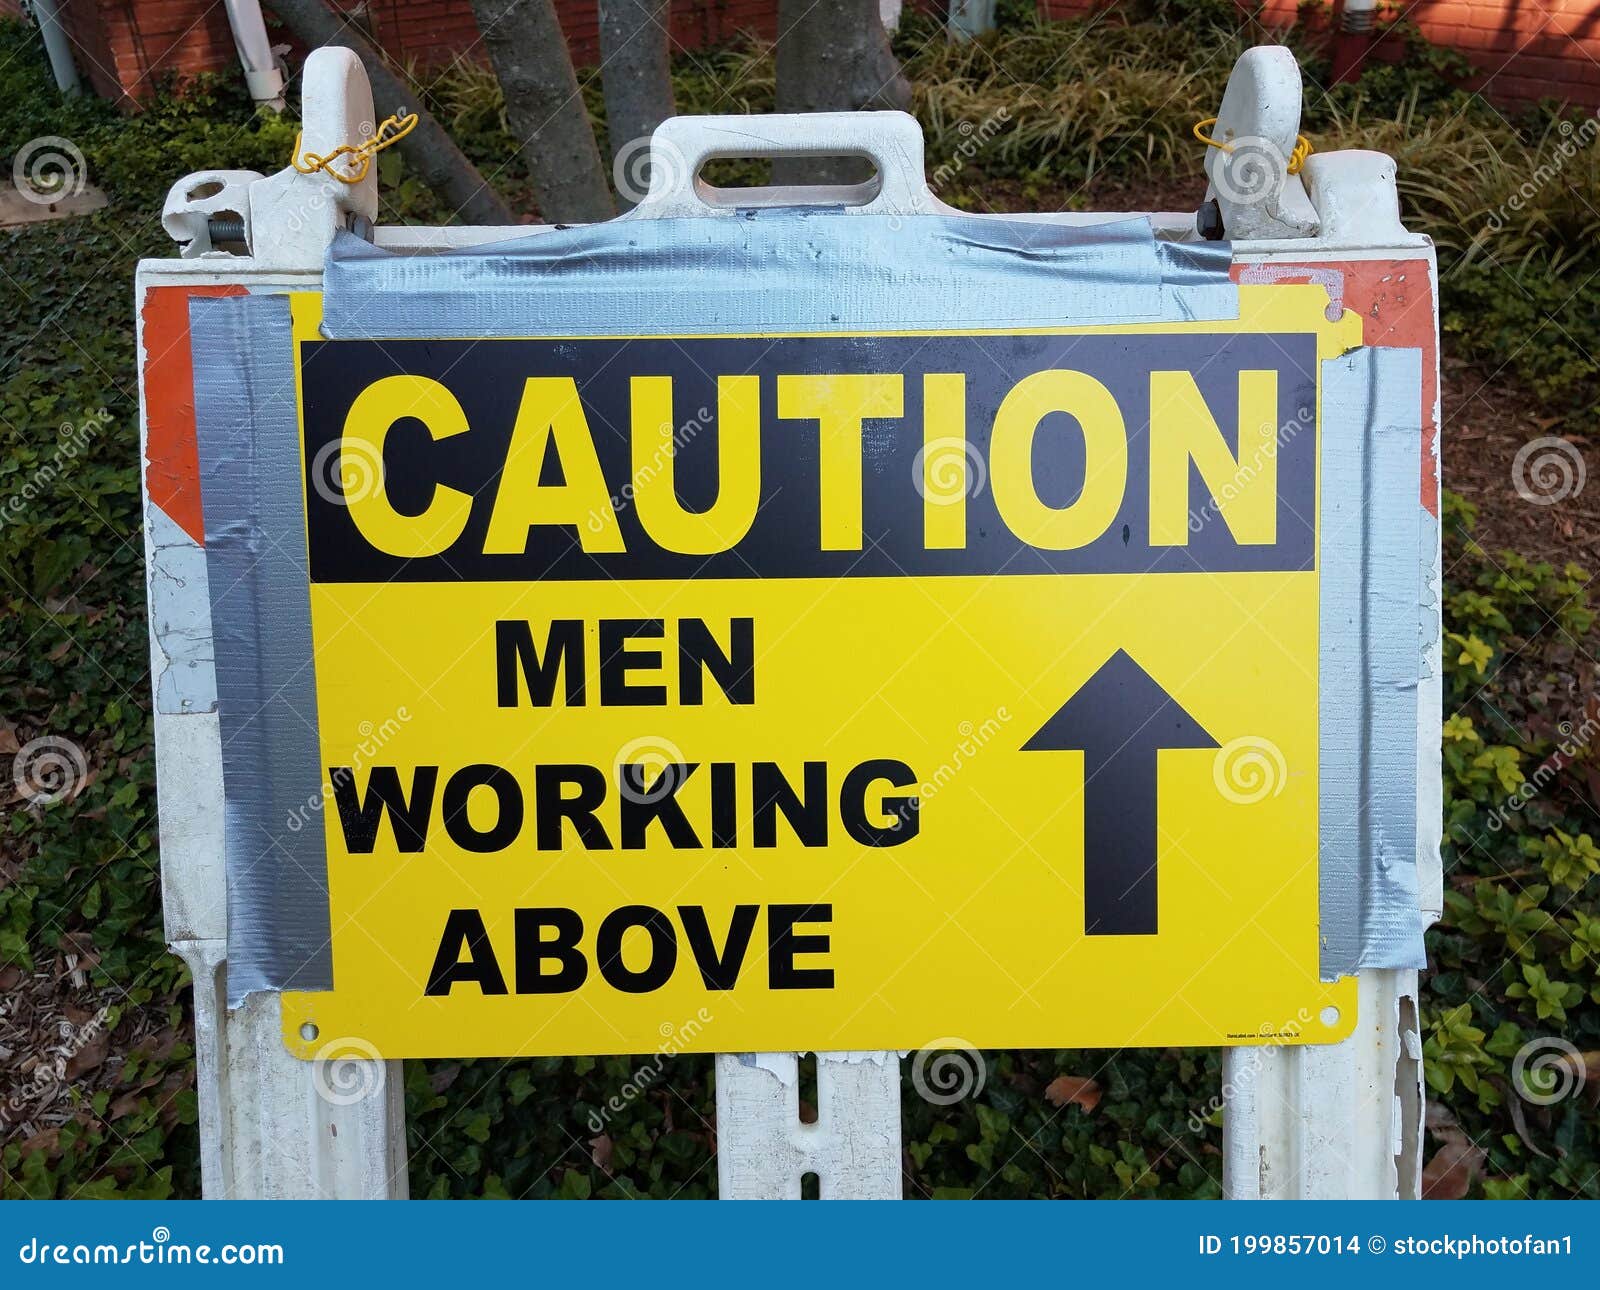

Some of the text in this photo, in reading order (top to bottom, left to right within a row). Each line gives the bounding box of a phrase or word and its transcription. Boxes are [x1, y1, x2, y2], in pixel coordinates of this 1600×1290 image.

[340, 368, 1278, 557] CAUTION
[495, 618, 756, 707] MEN
[329, 759, 921, 854] WORKING
[424, 904, 836, 996] ABOVE
